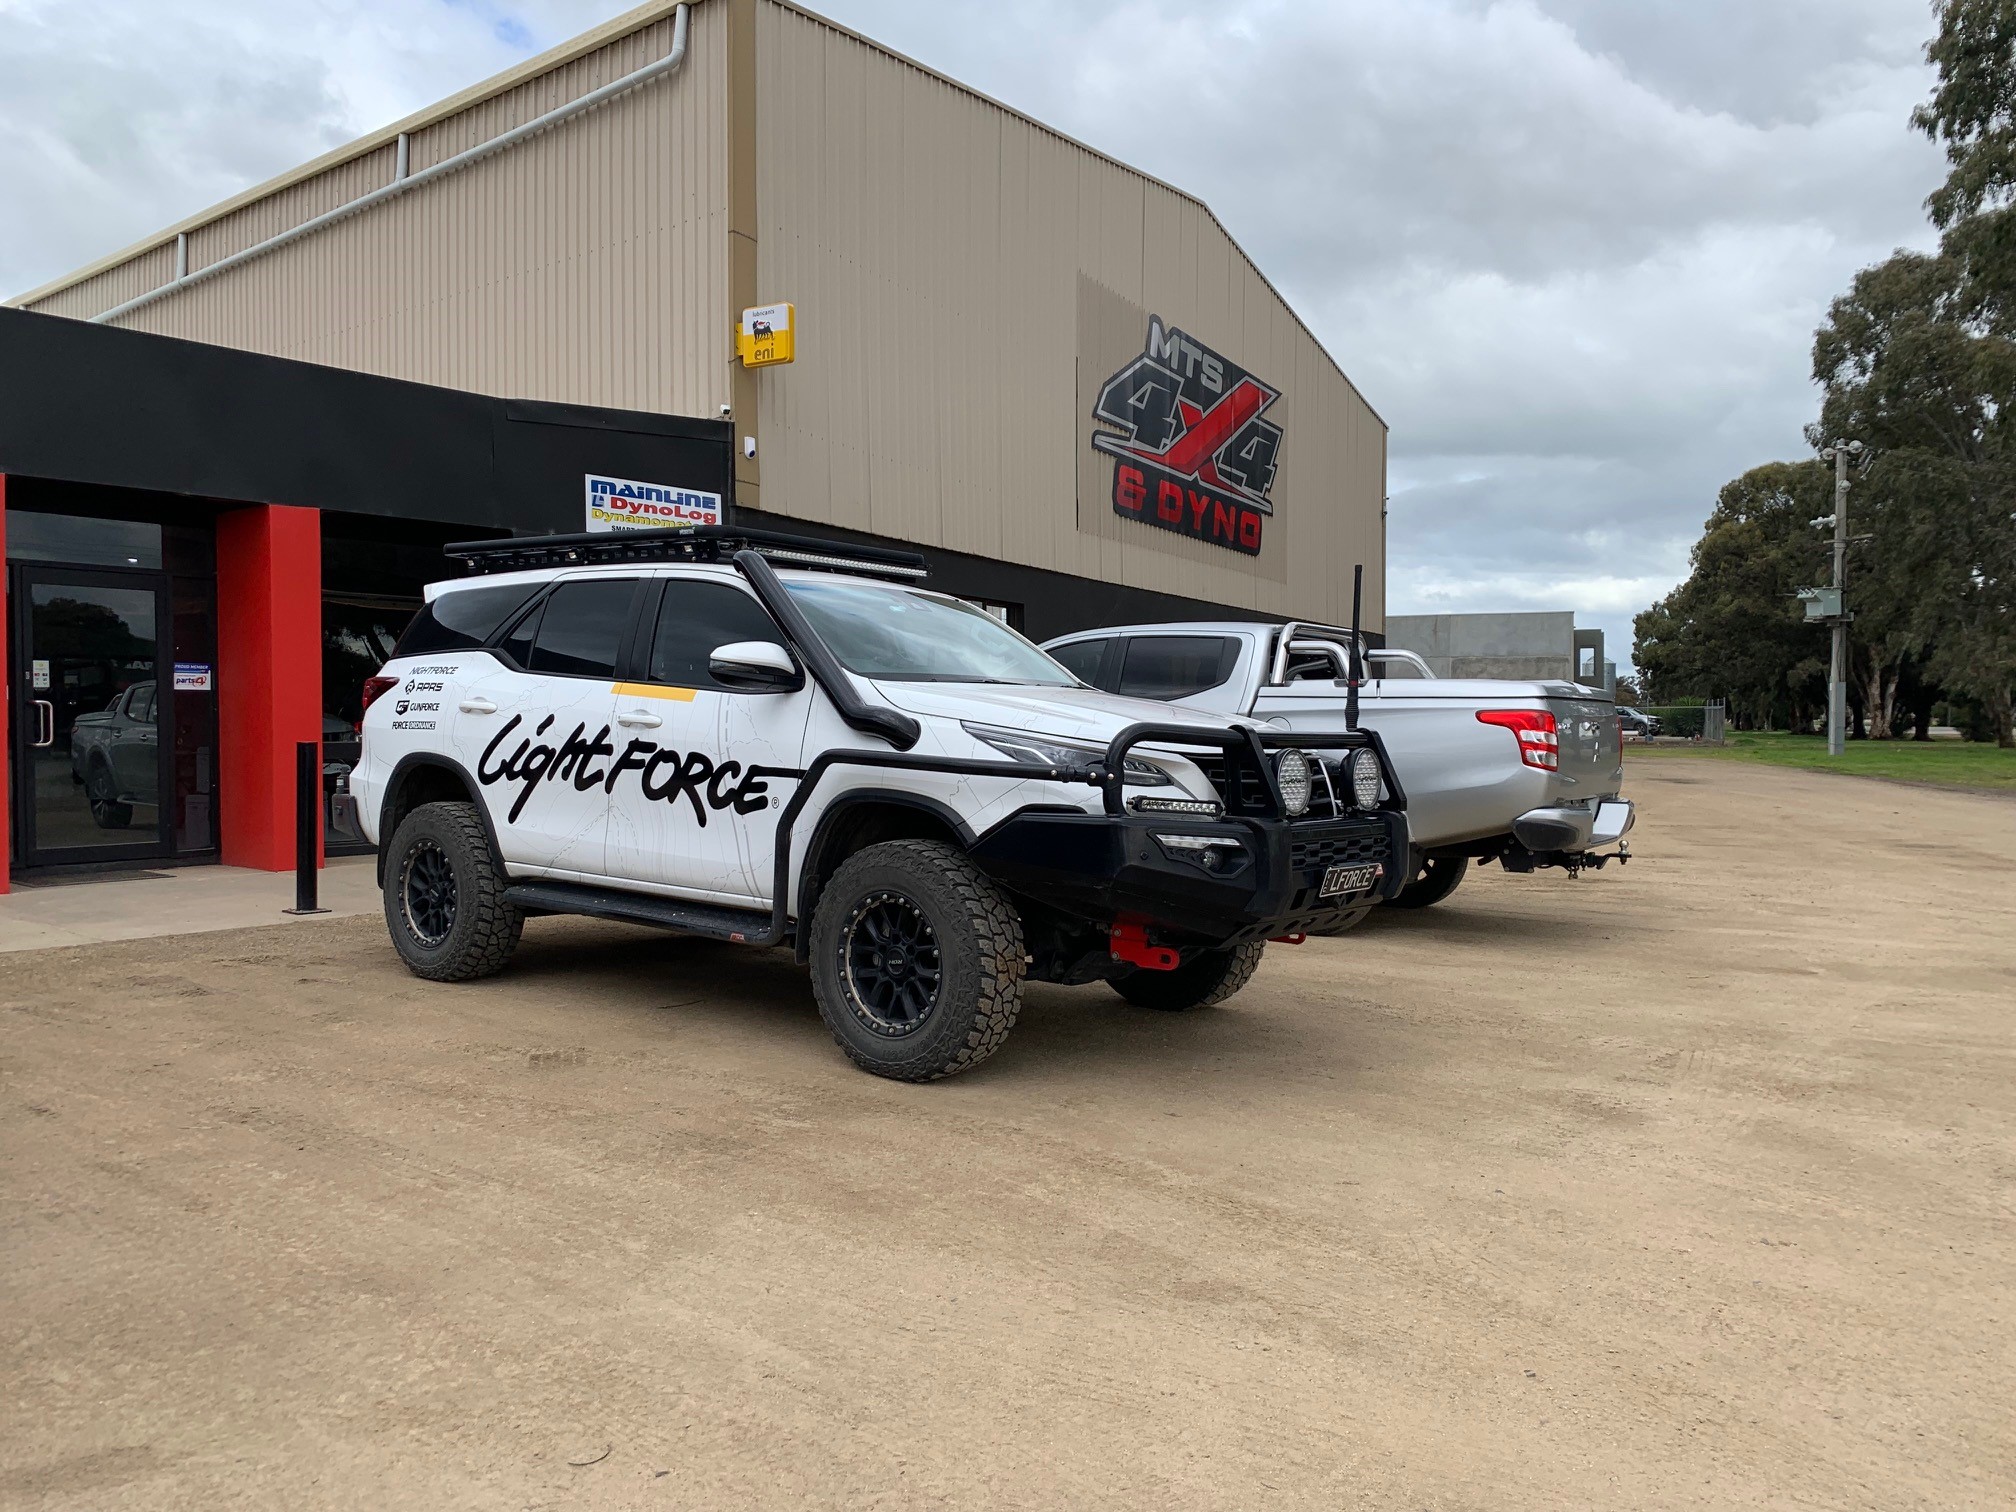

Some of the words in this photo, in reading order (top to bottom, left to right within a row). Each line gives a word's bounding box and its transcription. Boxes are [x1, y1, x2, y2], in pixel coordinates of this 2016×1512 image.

[754, 342, 774, 360] eni
[1149, 321, 1223, 394] MTS
[610, 497, 716, 525] DynoLog
[1116, 464, 1147, 511] &
[1157, 479, 1261, 549] DYNO
[408, 666, 459, 676] NIGHTFORCE
[392, 721, 408, 730] FORCE
[1329, 868, 1375, 891] LFORCE
